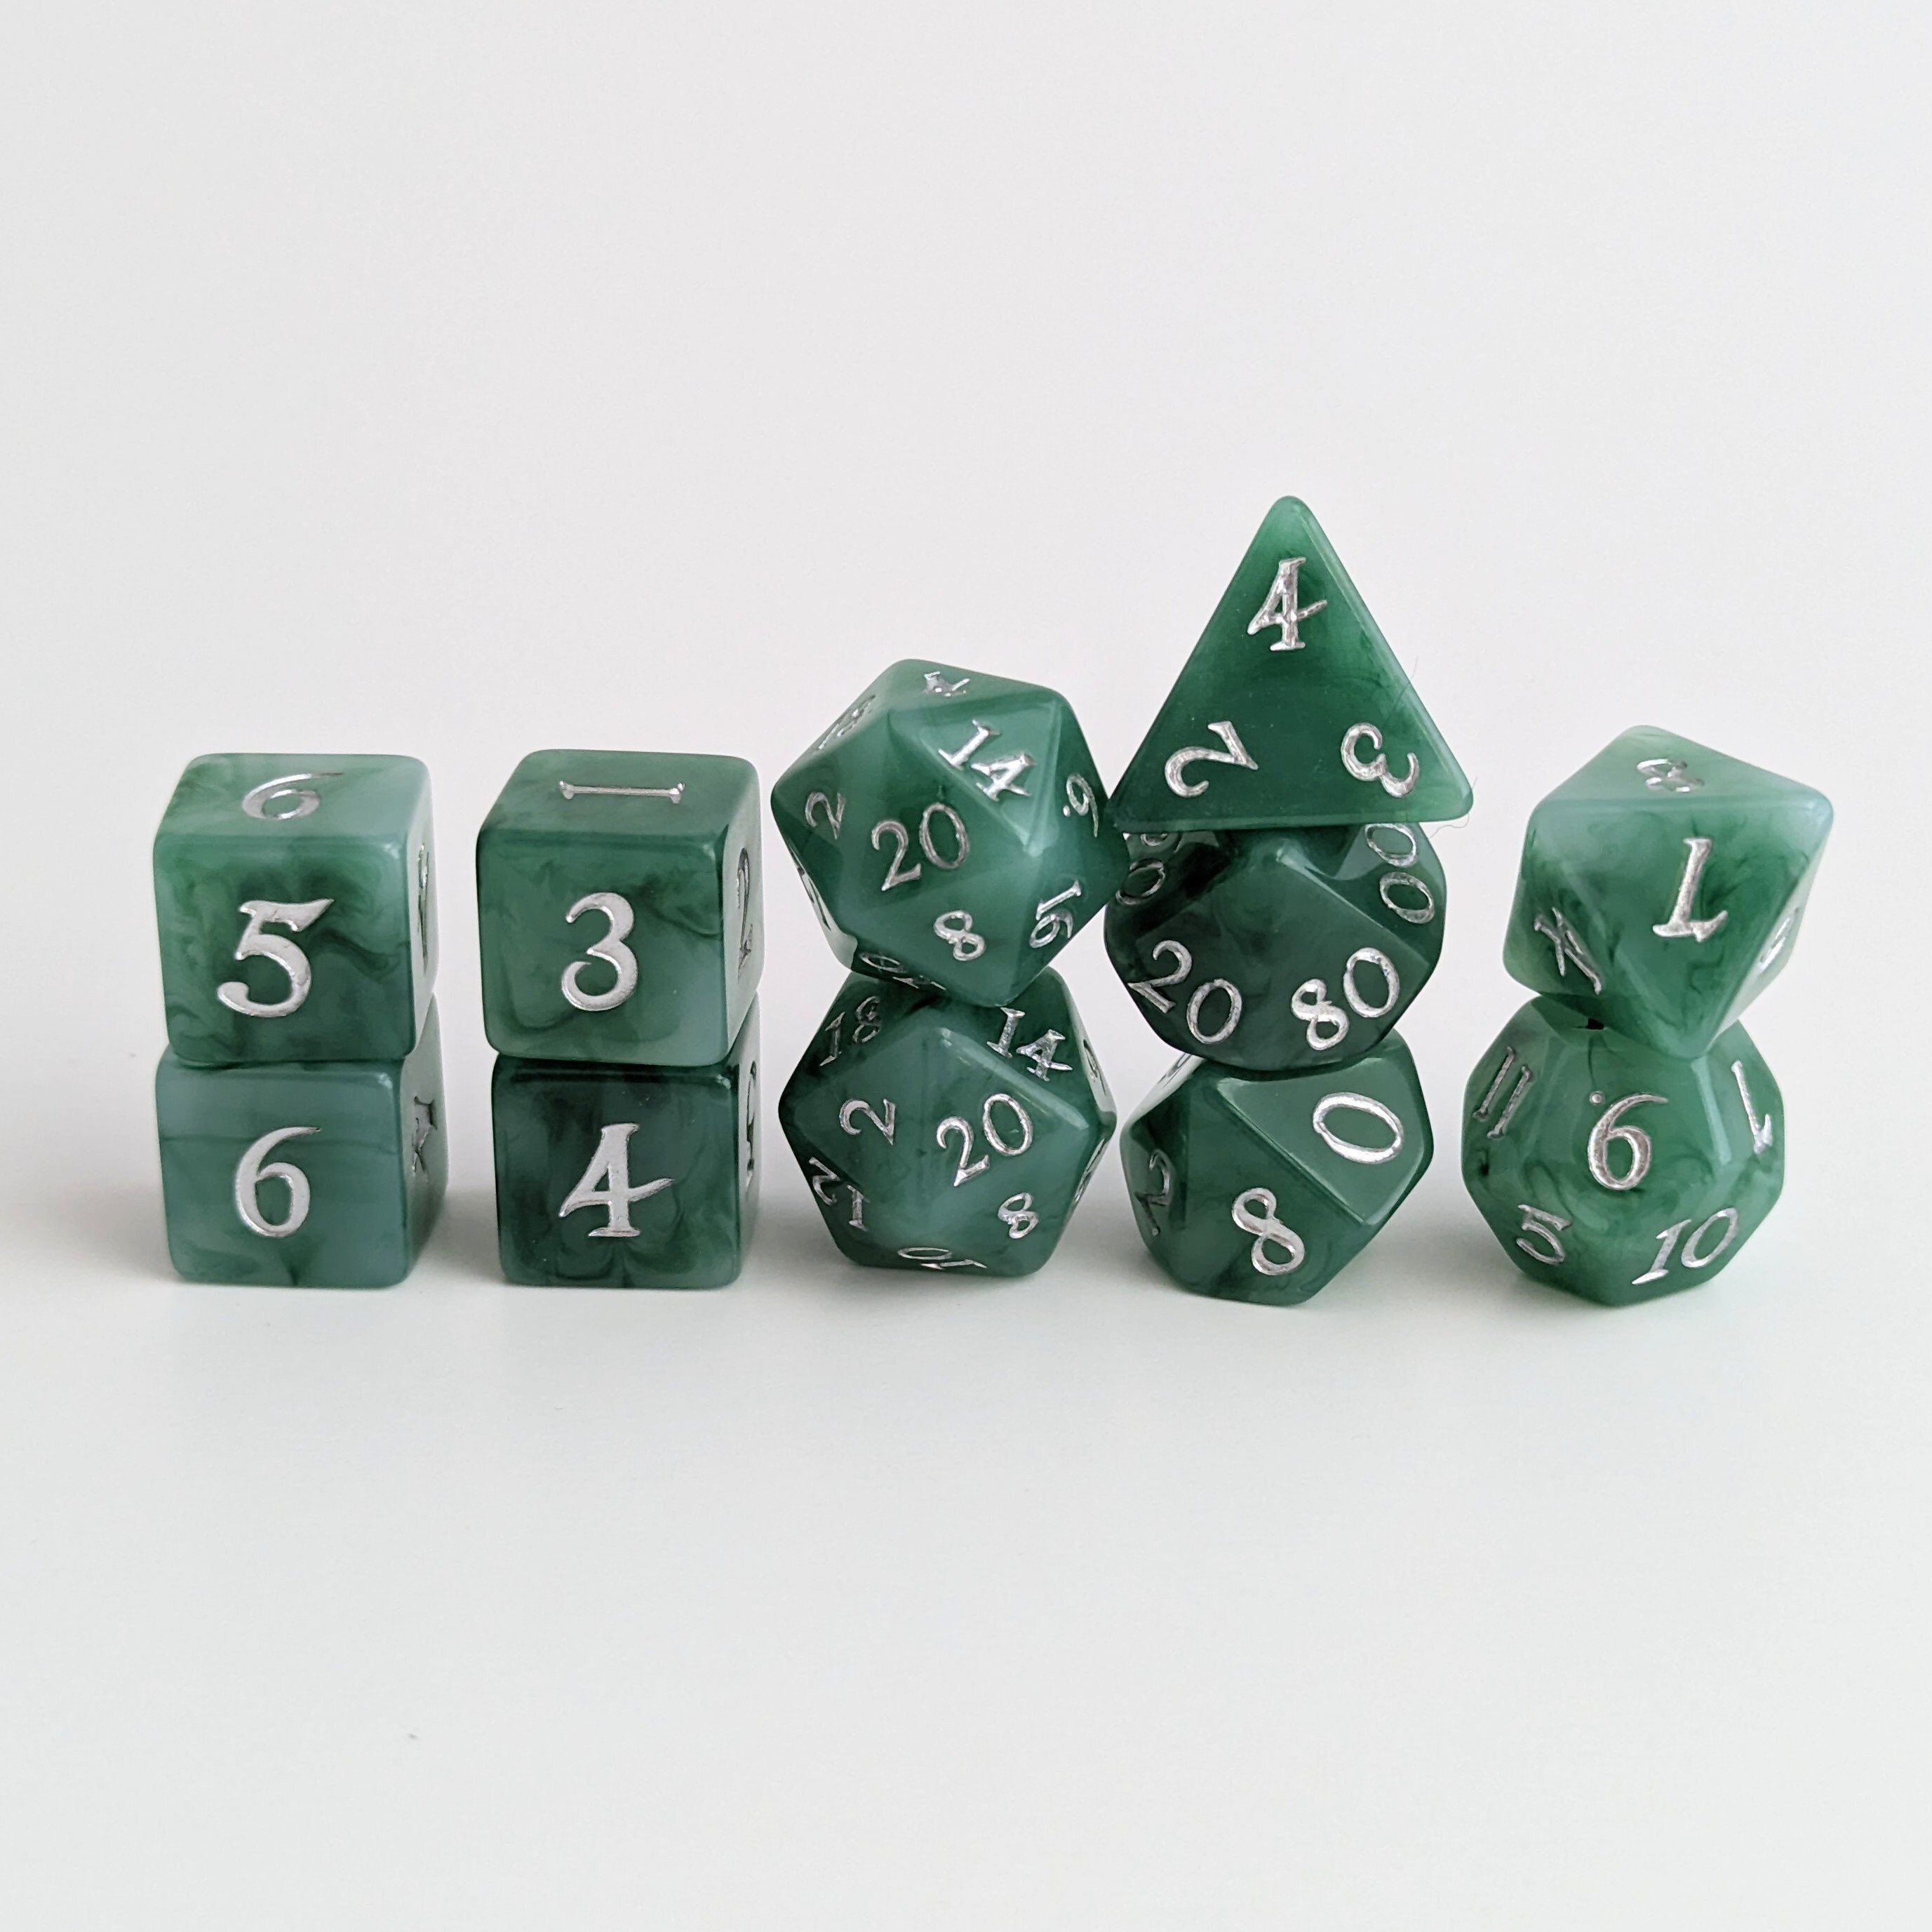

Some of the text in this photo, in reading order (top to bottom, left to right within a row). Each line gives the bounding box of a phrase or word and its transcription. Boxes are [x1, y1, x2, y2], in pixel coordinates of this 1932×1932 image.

[1247, 557, 1327, 652] 4
[241, 772, 343, 820] 6
[938, 719, 1035, 801] 14
[1165, 720, 1259, 798] 2
[1341, 723, 1419, 798] 3
[1636, 758, 1704, 793] 8
[805, 791, 845, 840] 2
[871, 803, 970, 892] 20
[217, 898, 335, 1017] 5
[561, 892, 638, 1011] 3
[934, 911, 986, 961] 8
[819, 995, 881, 1066] 18
[1127, 940, 1242, 1045] 20
[1291, 946, 1400, 1050] 80
[986, 1007, 1073, 1082] 14
[839, 1099, 897, 1146] 2
[1313, 1092, 1403, 1165] 0
[1473, 1046, 1535, 1139] 11
[936, 1093, 1033, 1187] 20
[235, 1126, 321, 1237] 6
[558, 1122, 676, 1237] 4
[998, 1192, 1039, 1239] 8
[1231, 1187, 1305, 1276] 8
[1516, 1204, 1572, 1265] 5
[1631, 1207, 1738, 1284] 10
